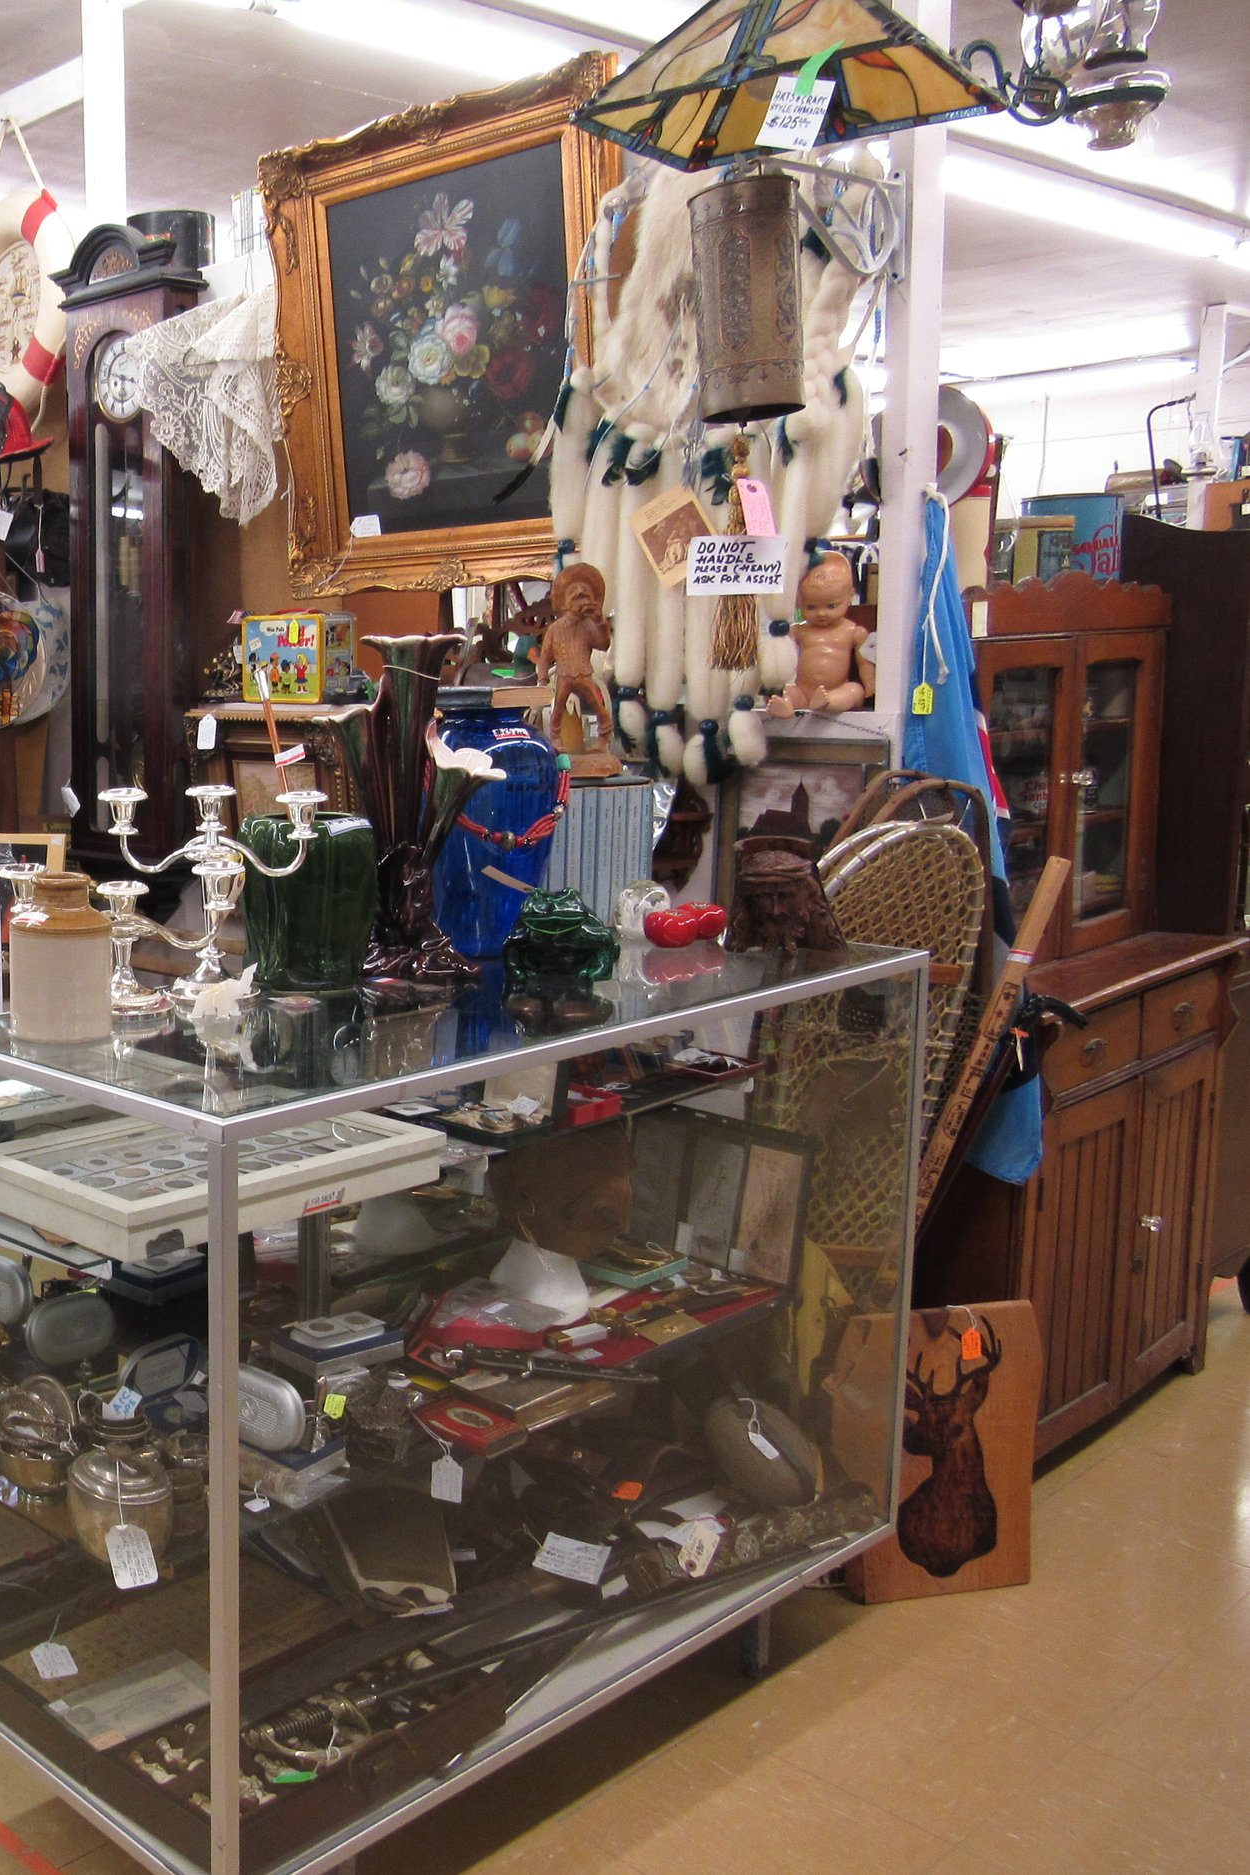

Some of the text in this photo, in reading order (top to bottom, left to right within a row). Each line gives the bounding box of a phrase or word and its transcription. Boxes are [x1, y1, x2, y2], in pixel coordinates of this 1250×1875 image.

[697, 541, 756, 554] DO NOT
[695, 553, 755, 564] HANDLE
[694, 560, 781, 575] PLEASE (HEAVY)
[693, 574, 782, 584] ASK FOR ASSIST
[277, 634, 315, 648] Poer!
